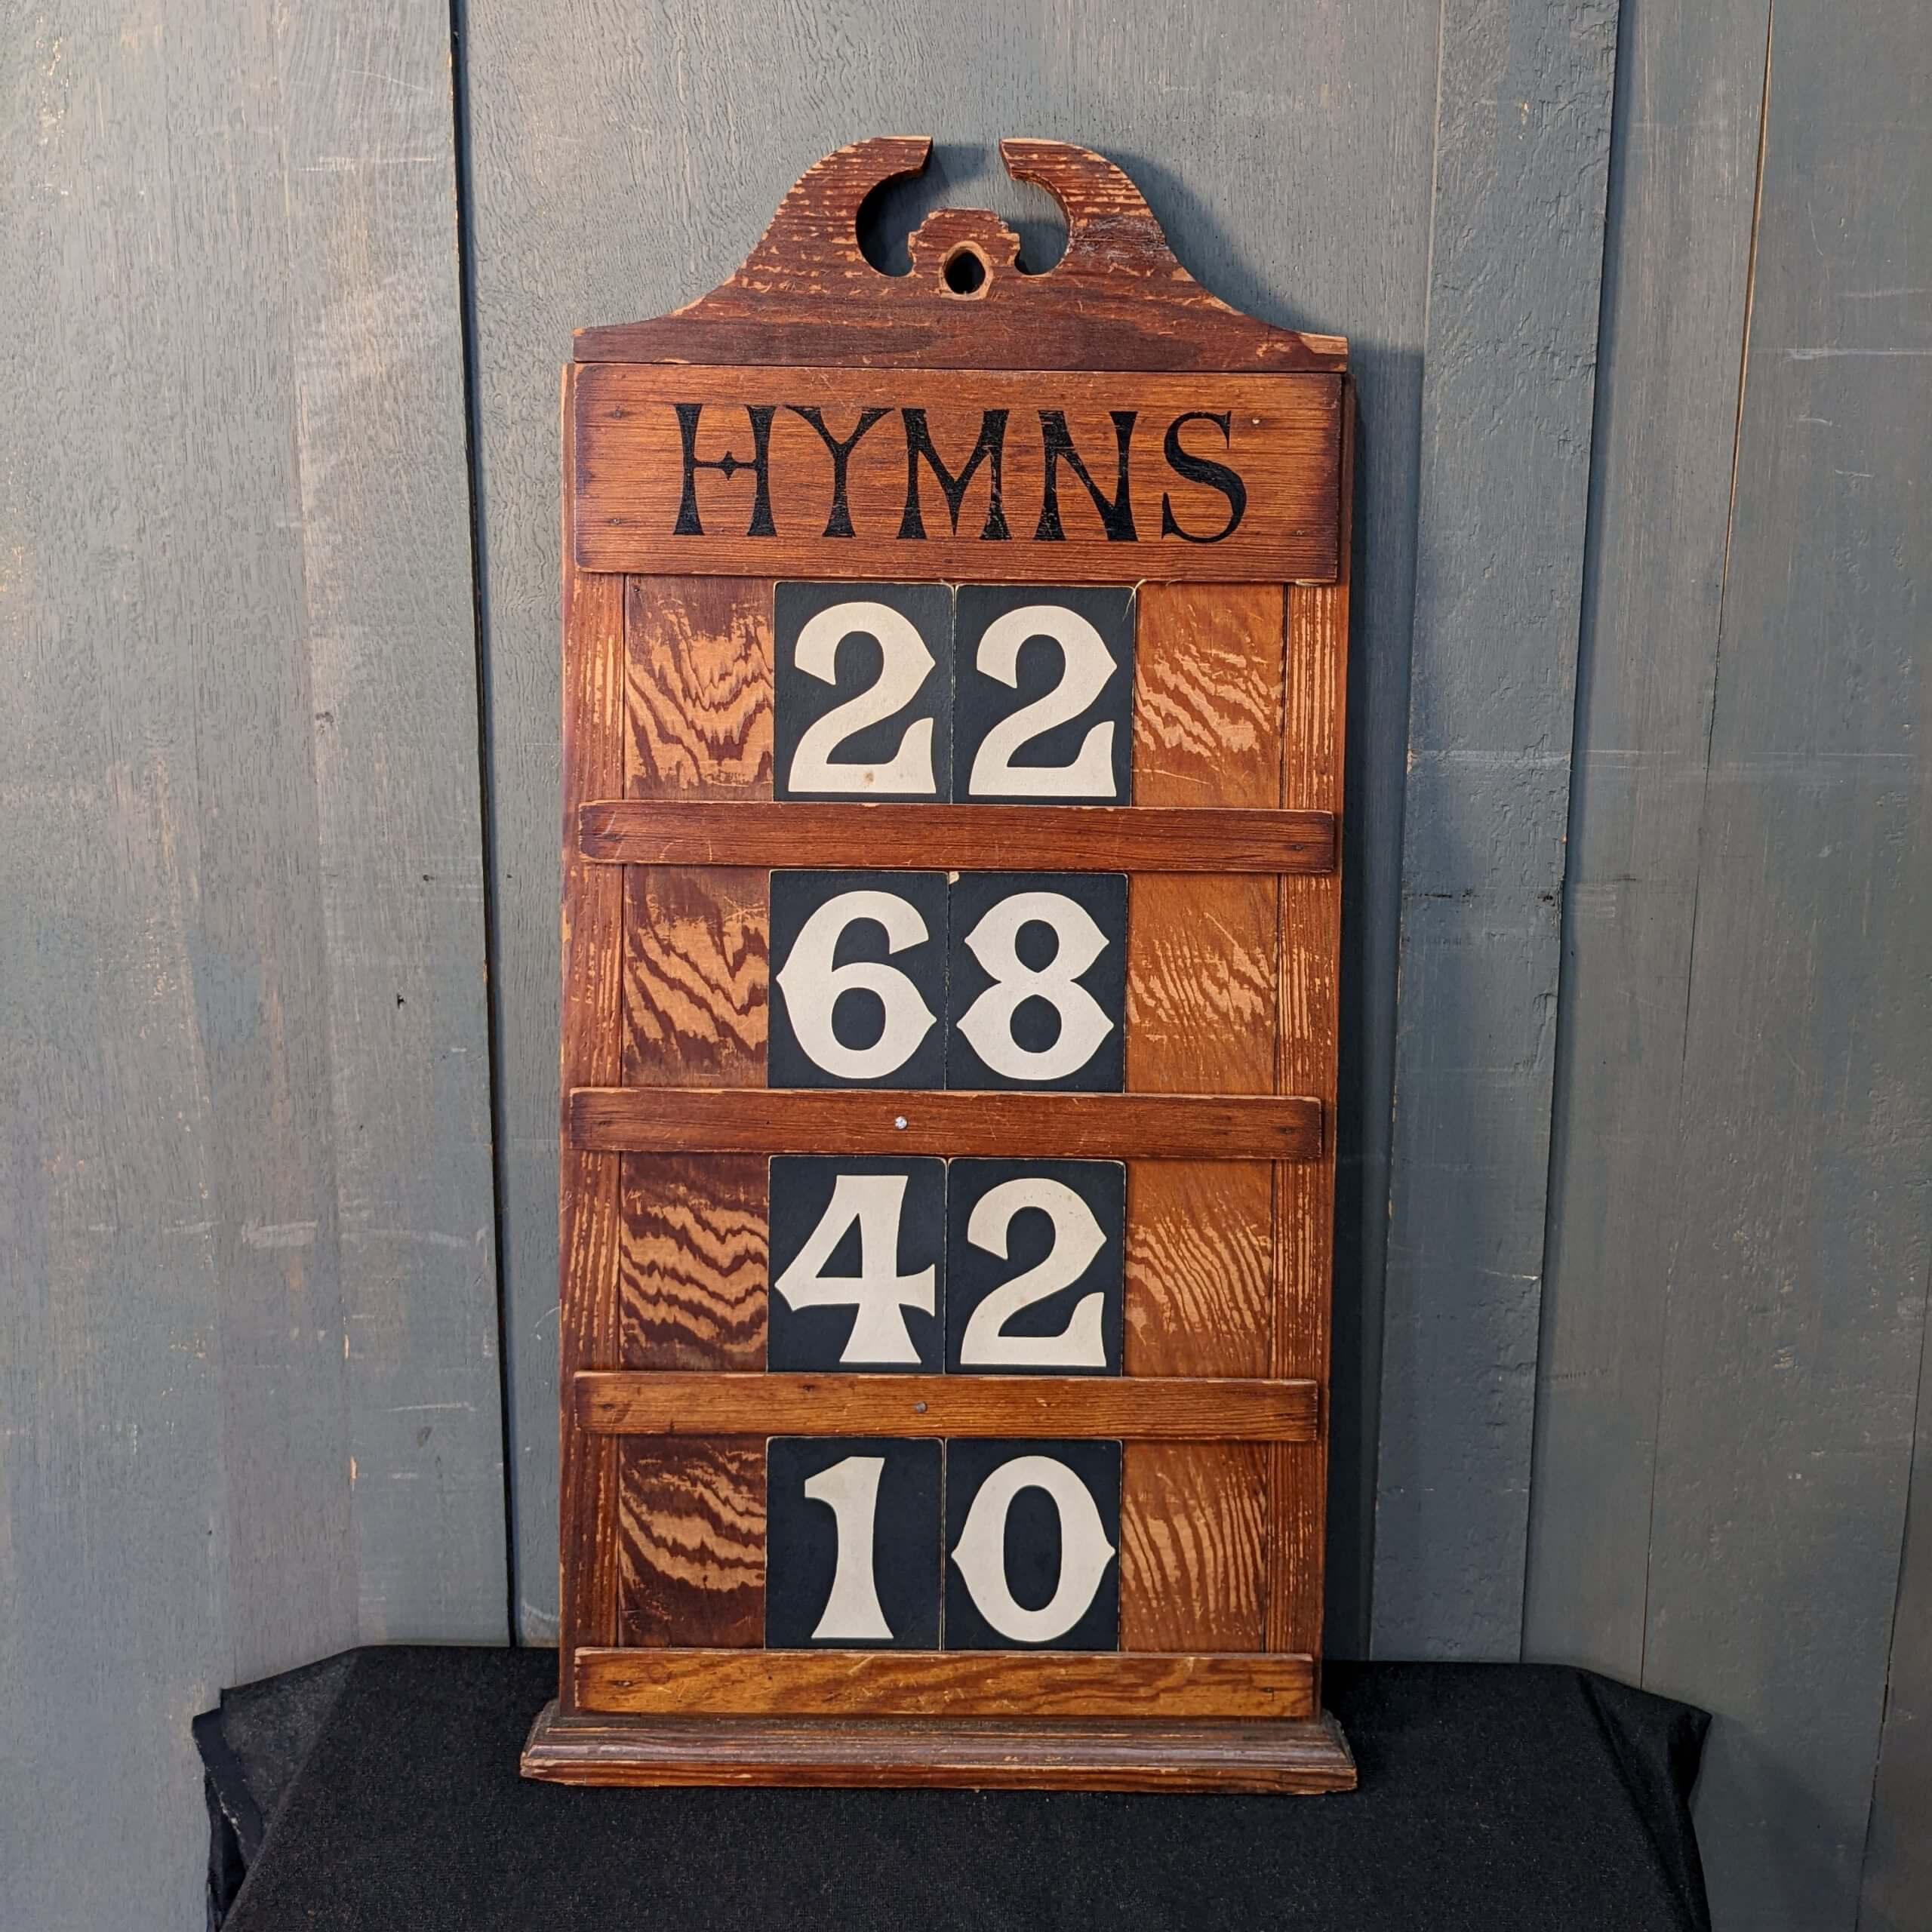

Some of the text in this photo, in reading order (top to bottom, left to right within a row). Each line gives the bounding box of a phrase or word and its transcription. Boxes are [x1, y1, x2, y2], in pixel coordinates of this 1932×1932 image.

[673, 403, 1247, 544] HYMNS
[786, 601, 1118, 798] 22
[776, 890, 1115, 1081] 68
[774, 1174, 1108, 1368] 42
[803, 1456, 1115, 1643] 10
